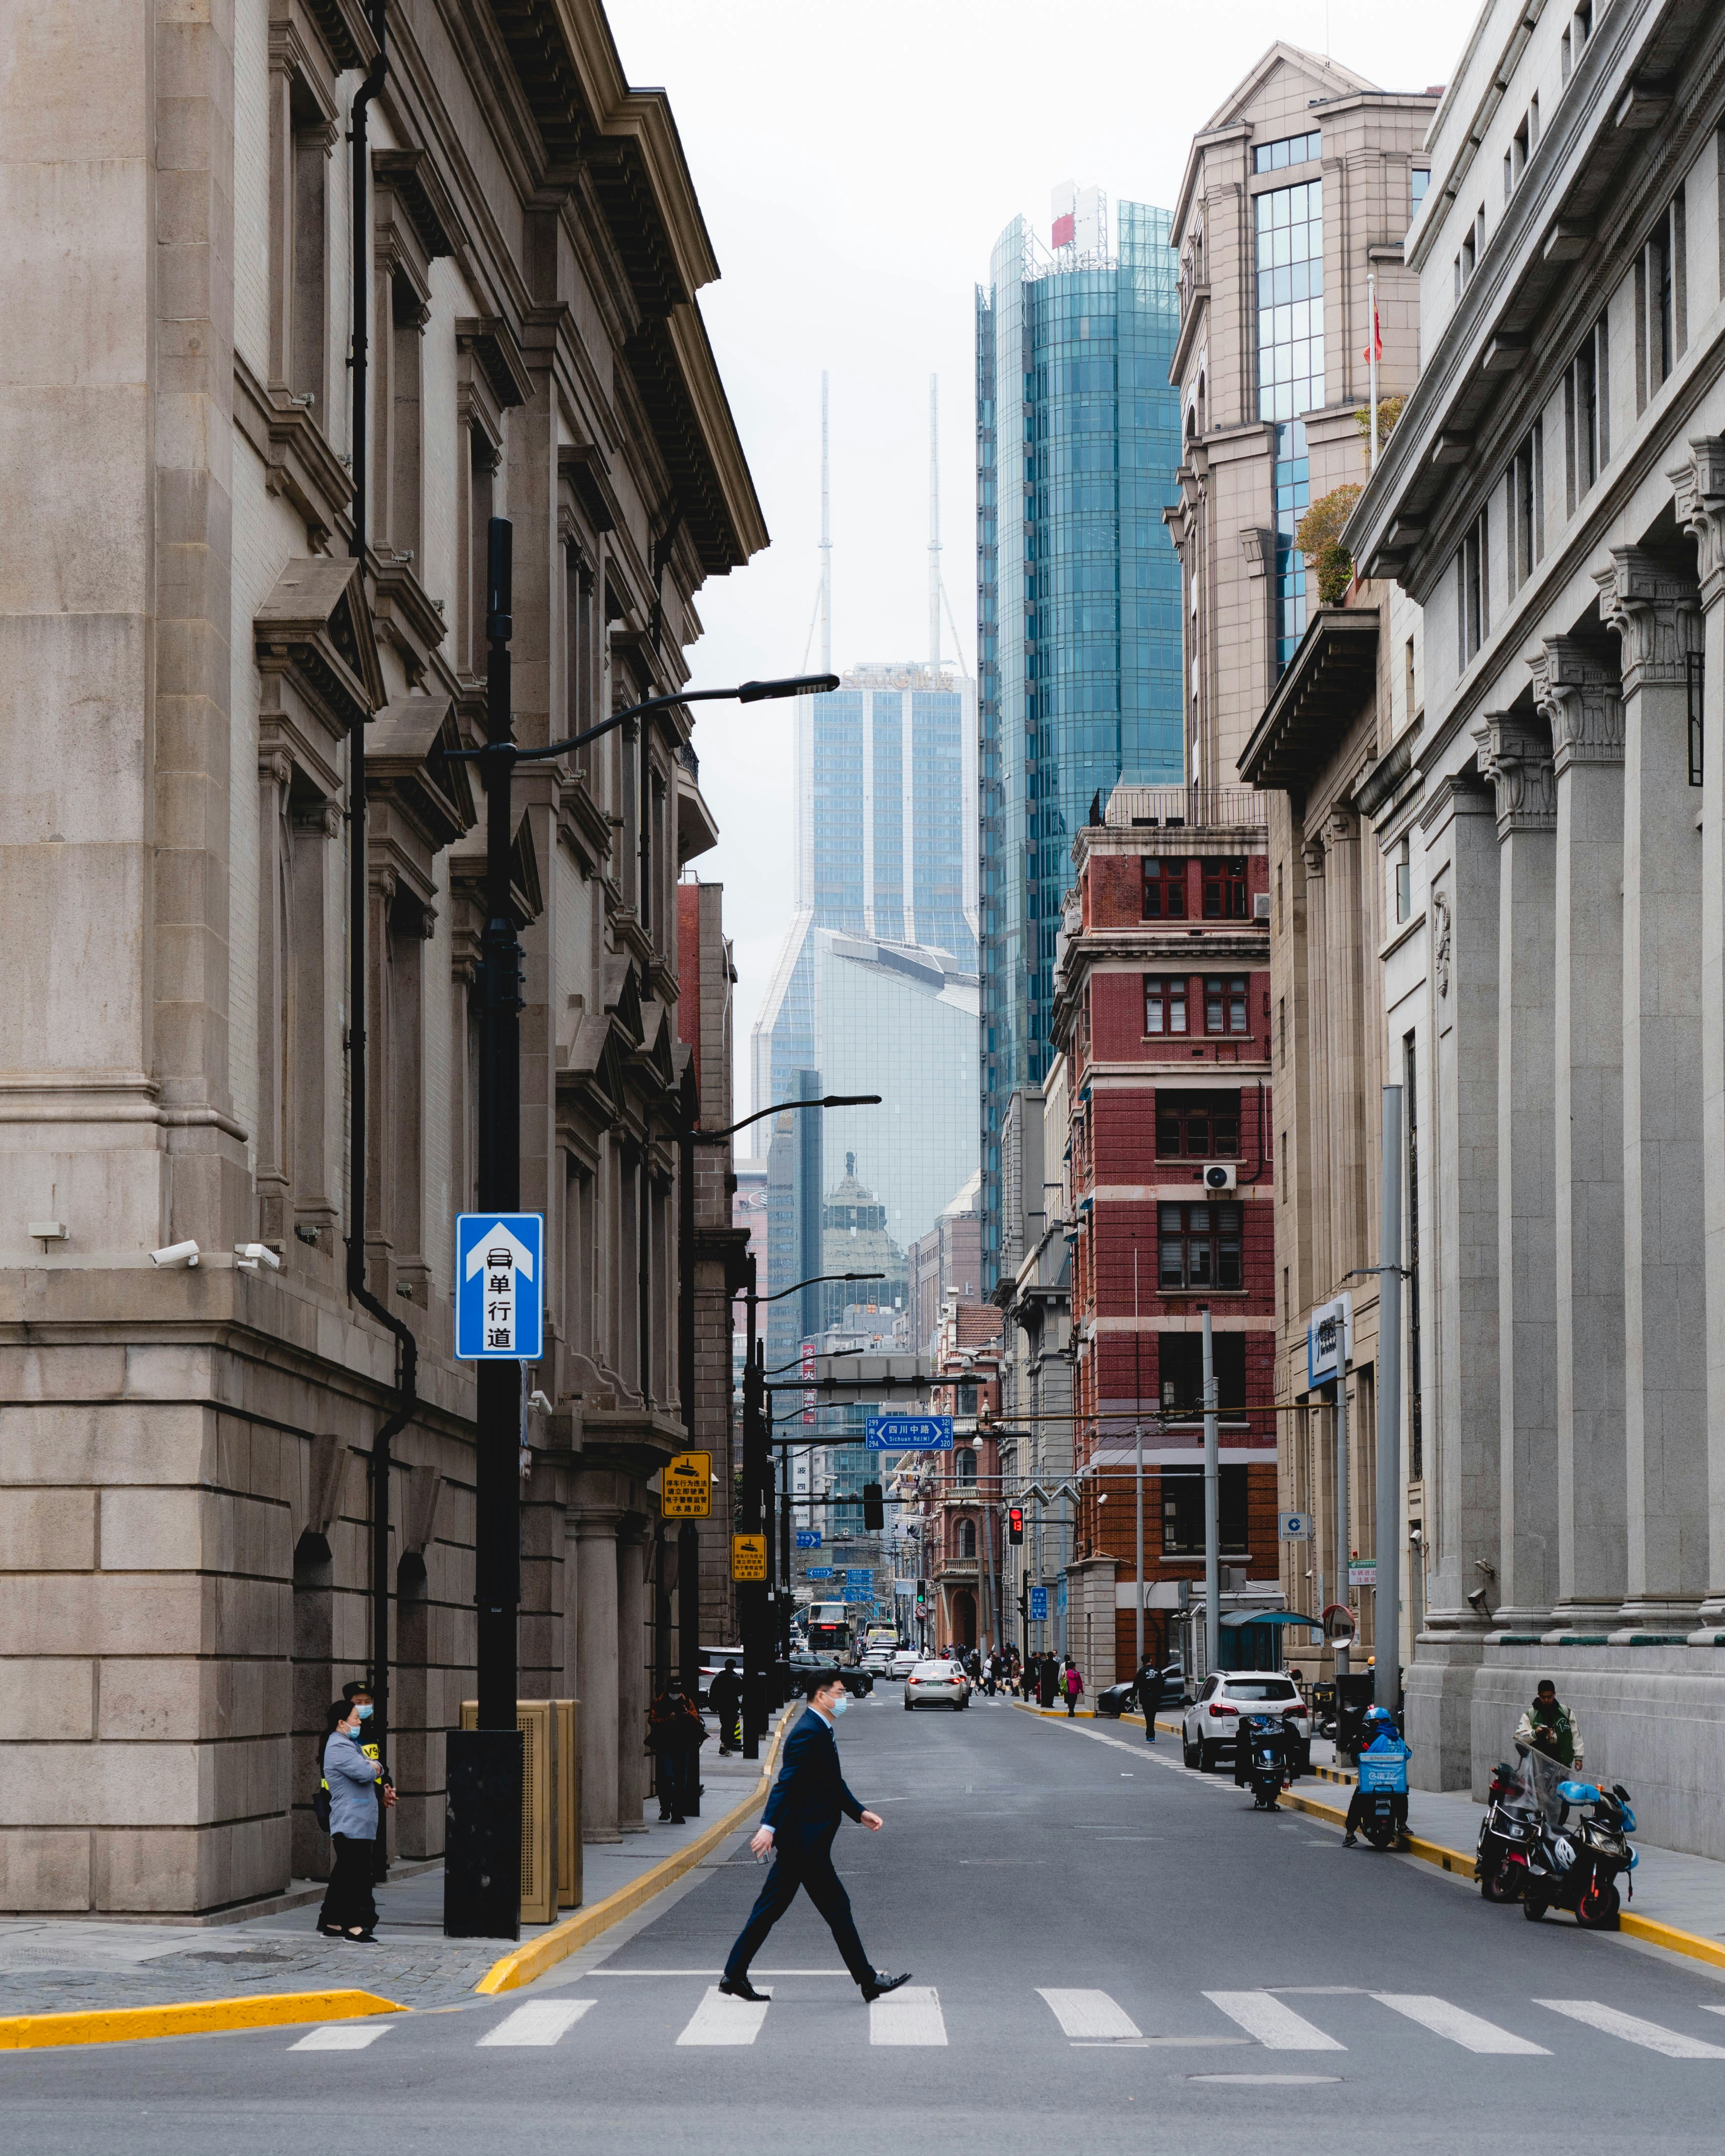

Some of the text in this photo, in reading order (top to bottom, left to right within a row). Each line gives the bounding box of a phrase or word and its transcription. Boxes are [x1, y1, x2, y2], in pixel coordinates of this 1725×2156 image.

[488, 1275, 511, 1348] 单行道
[889, 1425, 929, 1434] 四川中路
[1014, 1521, 1021, 1531] 13
